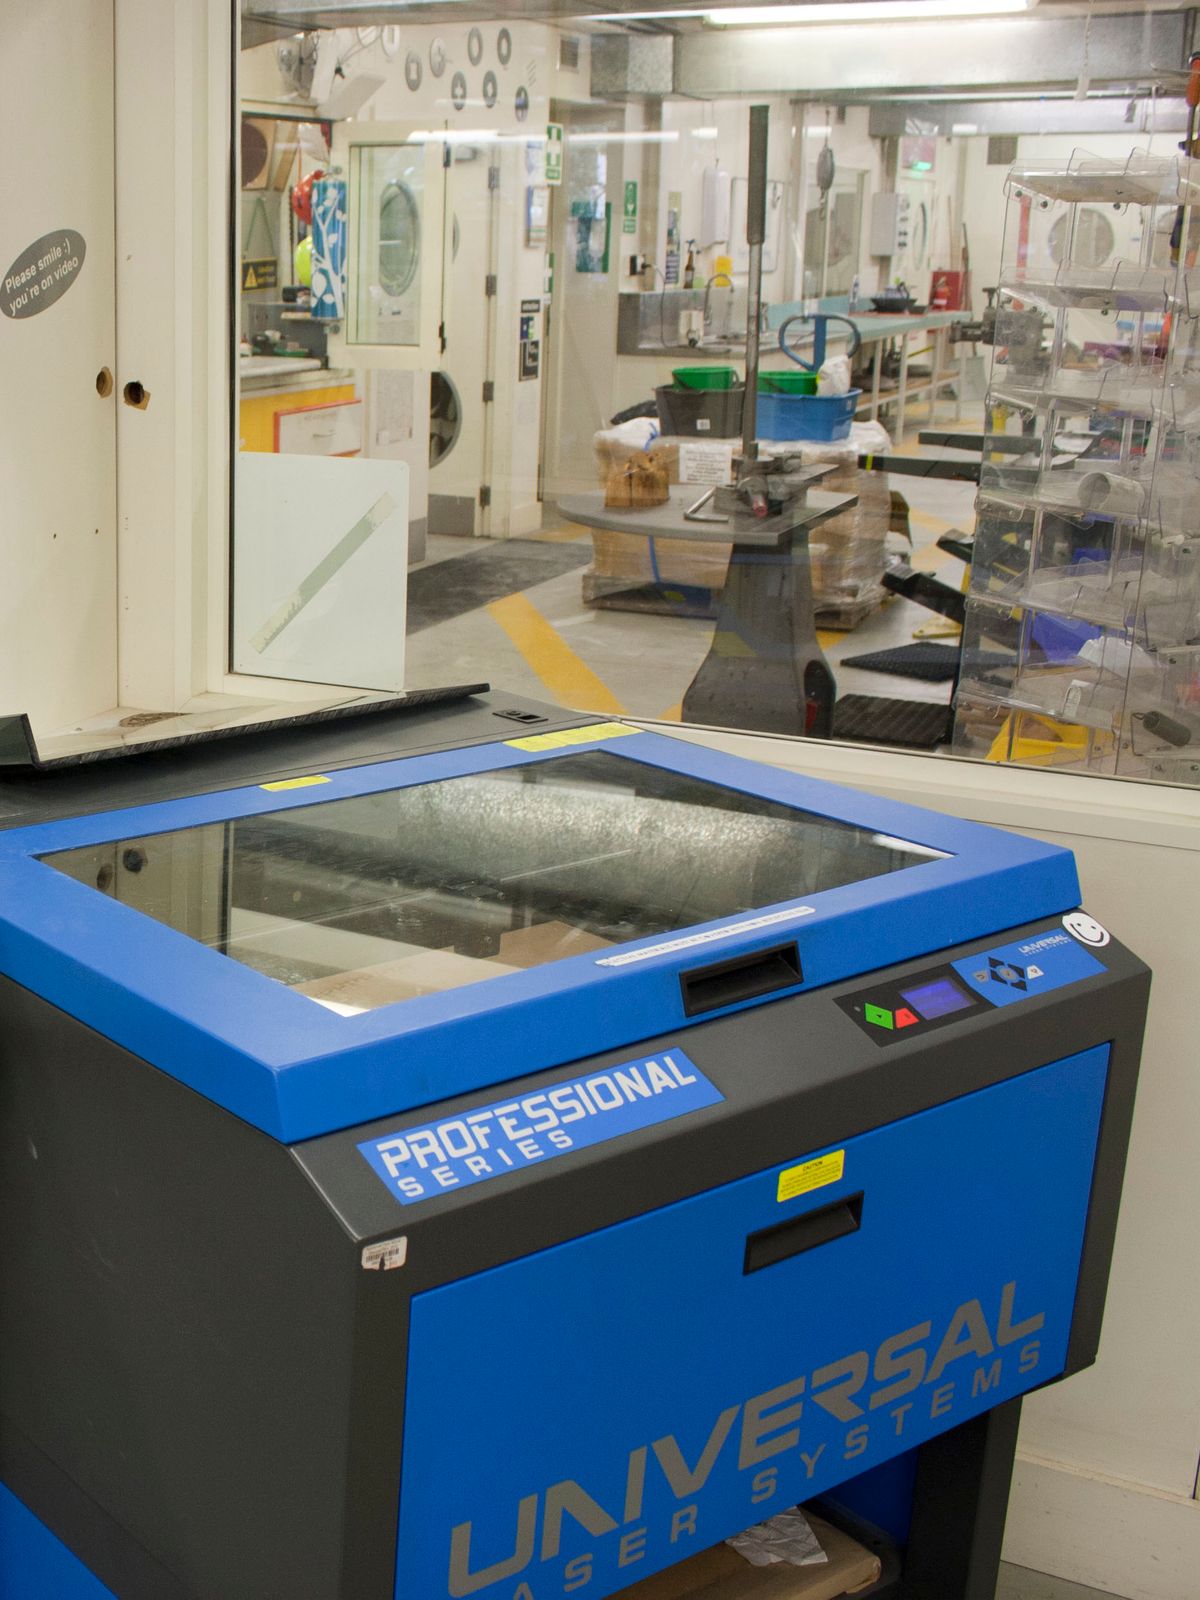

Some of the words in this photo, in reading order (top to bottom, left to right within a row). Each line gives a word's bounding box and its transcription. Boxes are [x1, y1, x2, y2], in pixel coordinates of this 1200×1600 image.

[5, 264, 36, 294] Please
[38, 246, 62, 271] smile
[41, 274, 53, 290] on
[54, 256, 78, 281] video
[1018, 934, 1069, 954] UNIVERSAL
[377, 1055, 697, 1178] PROFESSIONAL
[397, 1129, 573, 1198] SERIES
[802, 1160, 824, 1172] CAUTION
[448, 1281, 1045, 1598] UNIVERSAL
[512, 1505, 697, 1600] ASER
[751, 1341, 1041, 1504] SYSTEMS
